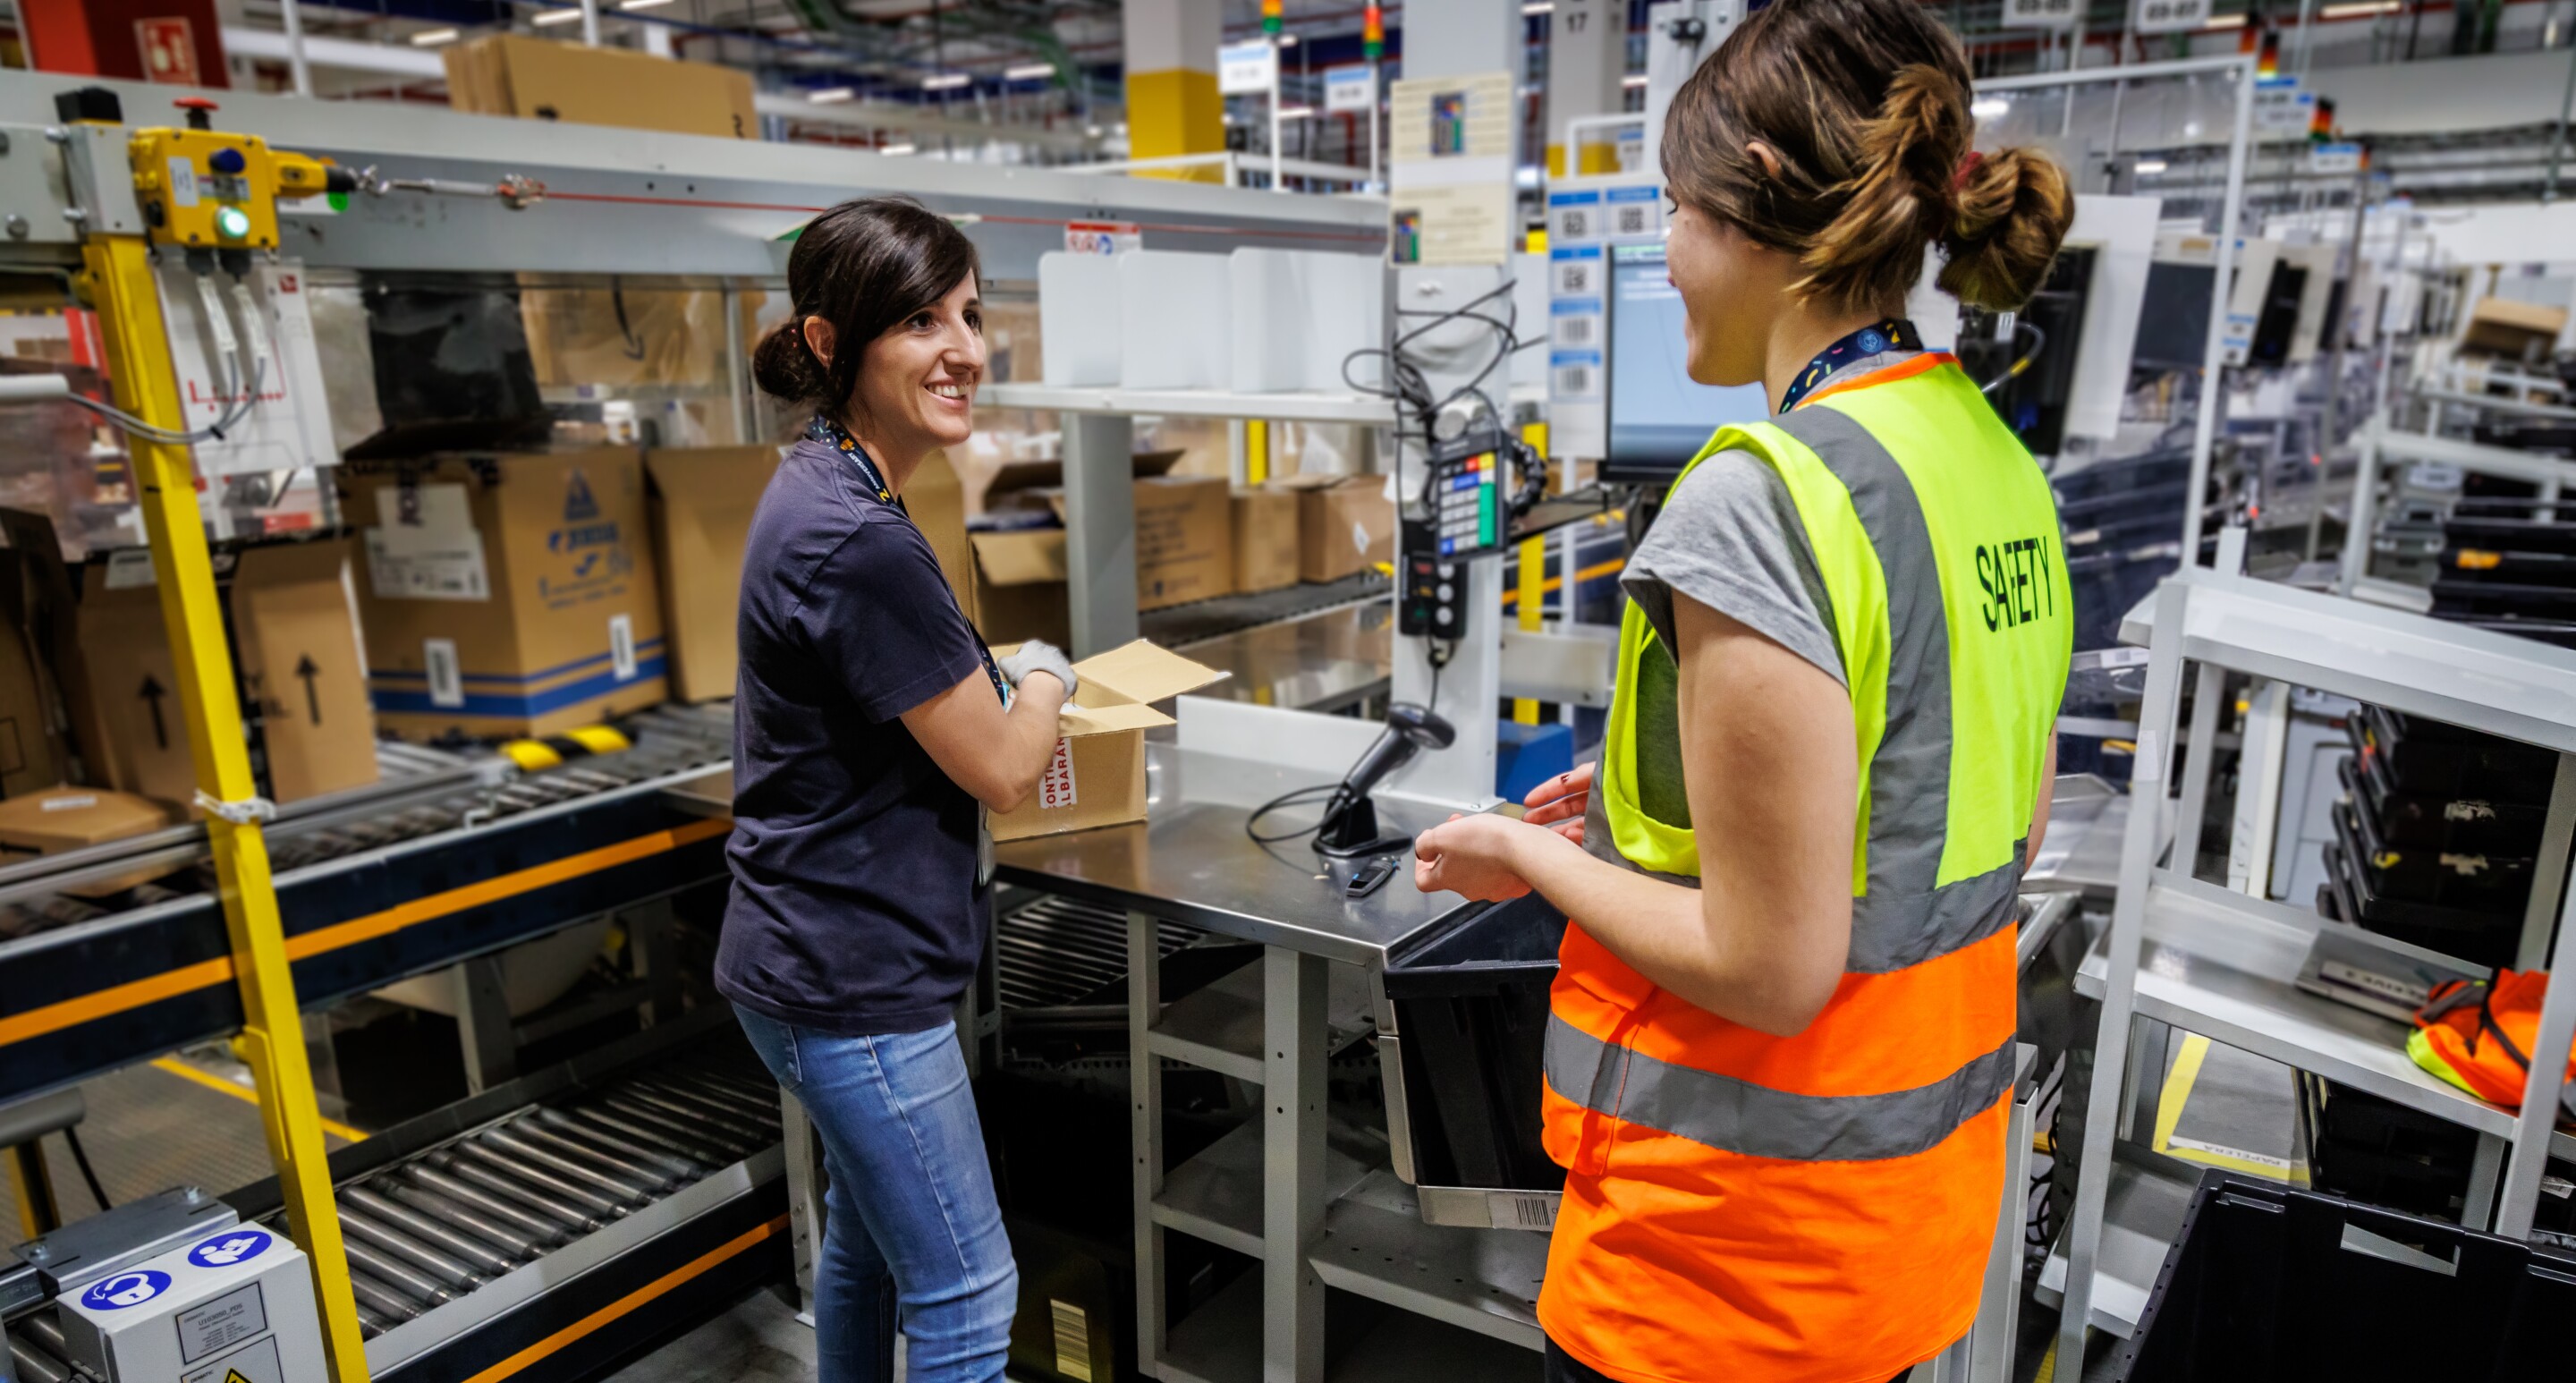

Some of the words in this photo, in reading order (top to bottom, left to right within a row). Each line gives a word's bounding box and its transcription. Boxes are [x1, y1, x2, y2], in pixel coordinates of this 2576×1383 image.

[1567, 12, 1589, 32] 17
[848, 452, 880, 489] ANNIVERSARY
[879, 488, 890, 502] 2
[1976, 536, 2052, 632] SAFETY
[190, 1370, 214, 1383] DEMATIC
